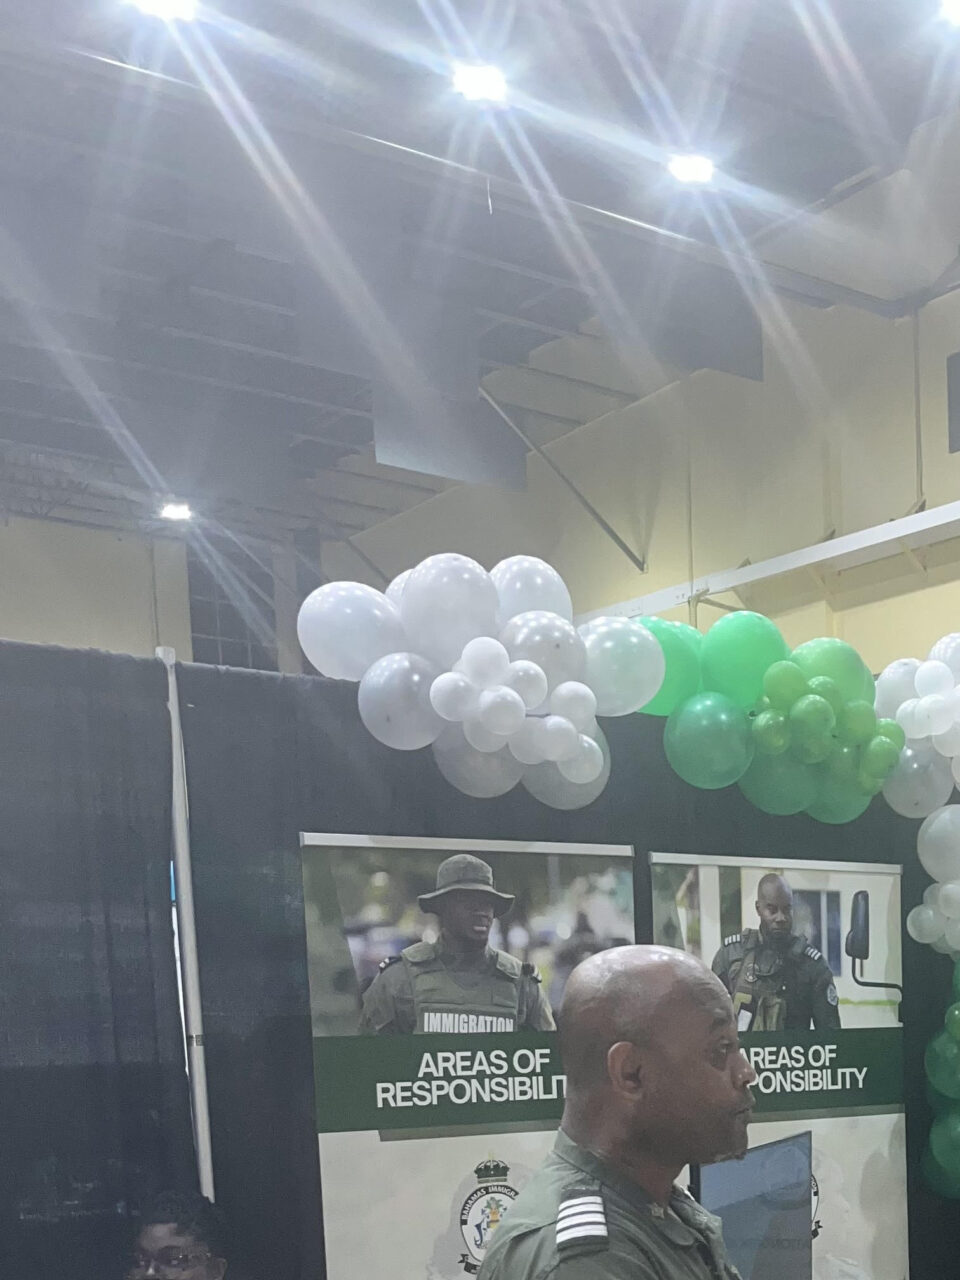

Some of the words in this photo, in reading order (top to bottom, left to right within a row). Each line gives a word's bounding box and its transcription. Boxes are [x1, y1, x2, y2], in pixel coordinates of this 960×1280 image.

[423, 1012, 514, 1034] IMMIGRATION
[417, 1050, 509, 1078] AREAS
[512, 1048, 551, 1074] OF
[808, 1045, 837, 1067] OF
[376, 1074, 567, 1108] RESPONSIBILIT
[752, 1067, 868, 1094] ONSIBILITY
[461, 1188, 488, 1221] BAHAMAS
[487, 1185, 517, 1198] IMMIGR
